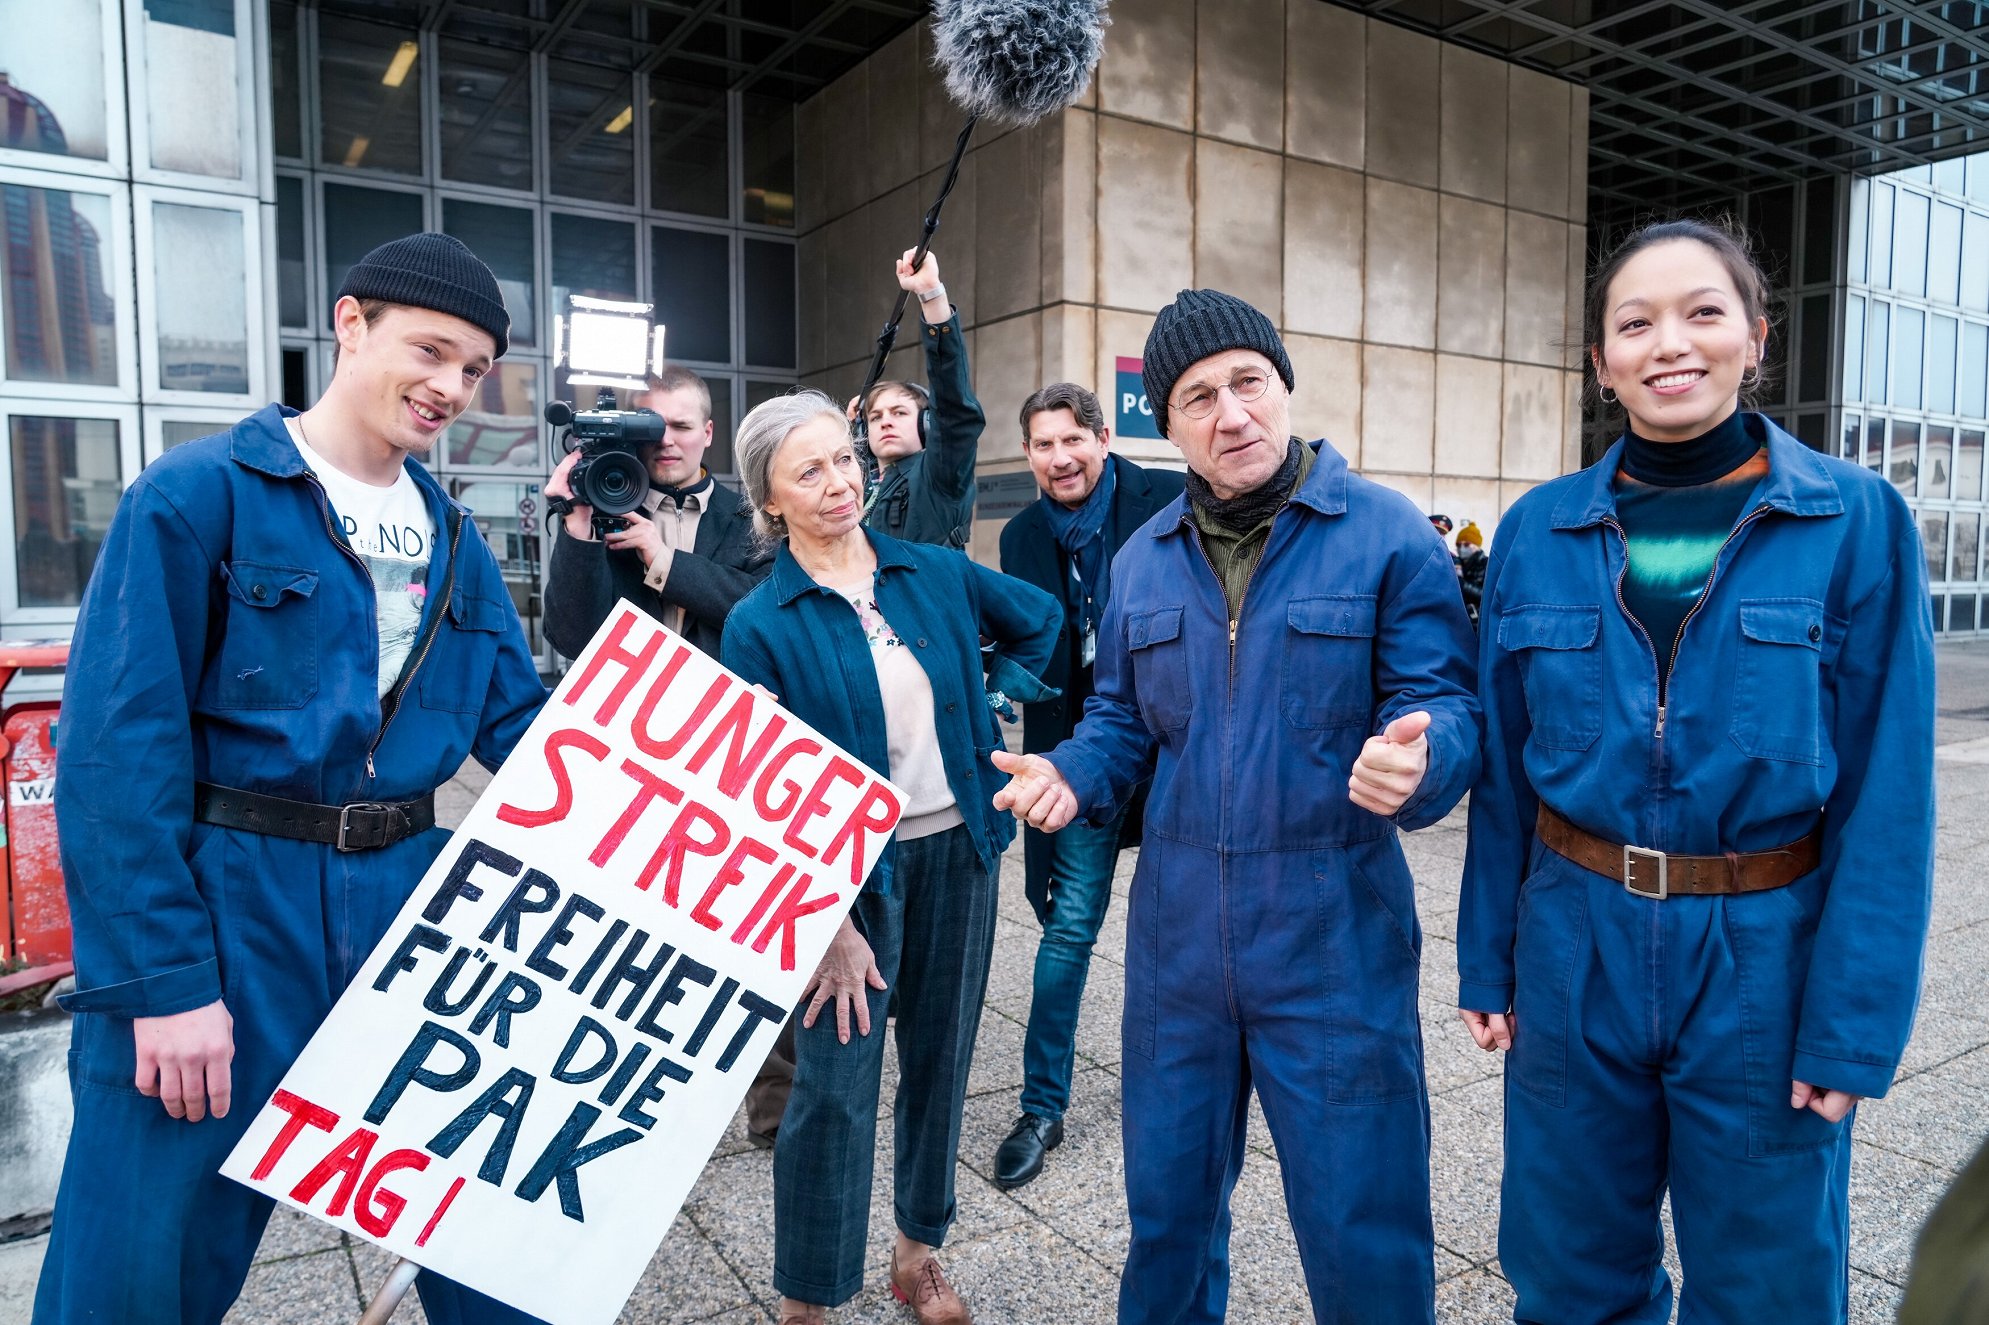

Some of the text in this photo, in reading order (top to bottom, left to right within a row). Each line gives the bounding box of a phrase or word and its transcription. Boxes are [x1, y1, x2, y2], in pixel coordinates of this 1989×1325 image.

[496, 729, 839, 971] STREIK
[563, 610, 900, 886] HUNGER
[372, 923, 693, 1131] FÜR DIE
[421, 839, 788, 1073] FREIHEIT
[362, 1020, 644, 1223] PAK
